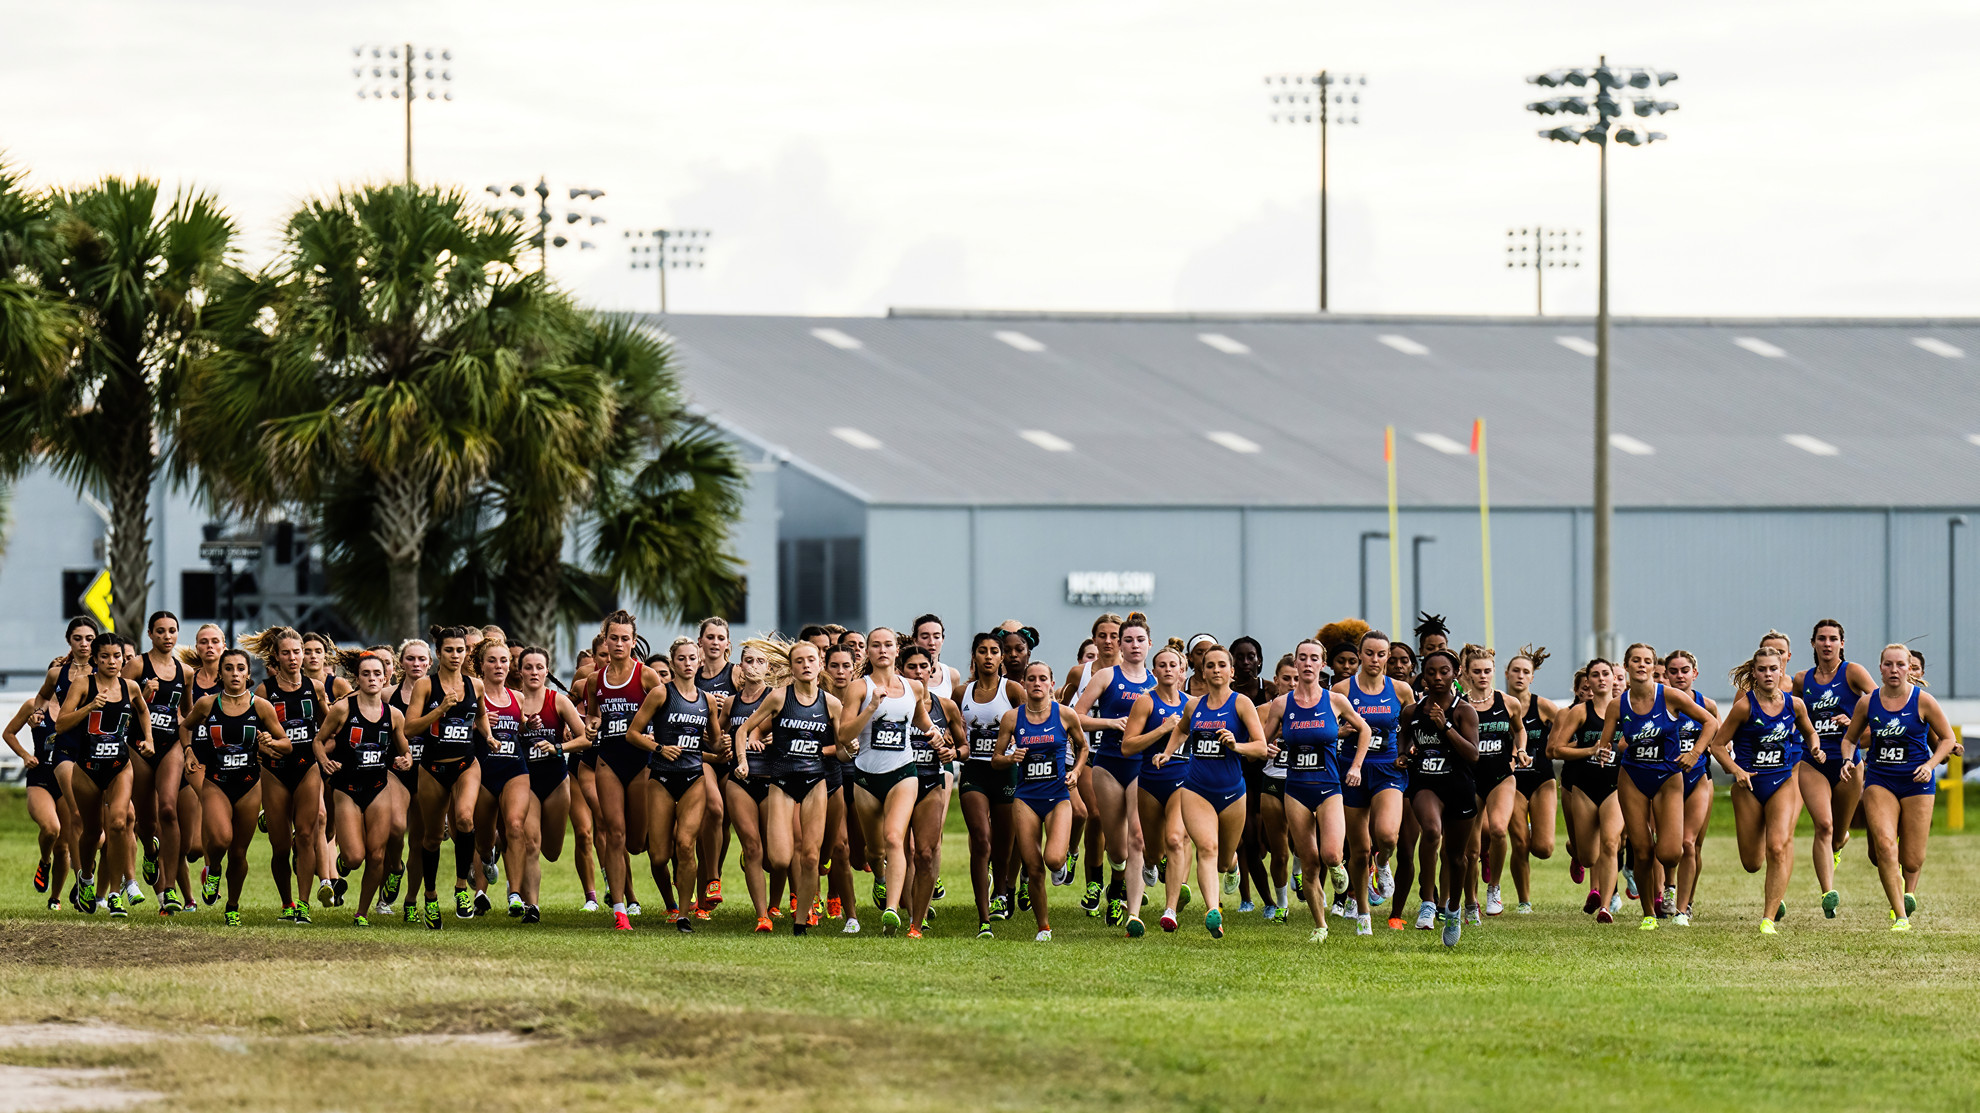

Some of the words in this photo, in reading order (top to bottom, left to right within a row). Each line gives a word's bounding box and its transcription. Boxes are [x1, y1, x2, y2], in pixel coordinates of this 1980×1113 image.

[599, 703, 639, 713] ATLANTIC
[1357, 705, 1391, 714] FLORIDA
[1812, 696, 1840, 711] FGCU
[150, 712, 173, 728] 963
[667, 712, 708, 726] KNIGHT
[779, 718, 828, 733] KNIGHTS
[1193, 720, 1227, 729] FLORIDA
[1290, 720, 1325, 730] FLORIDA
[1815, 719, 1839, 733] 944
[286, 726, 308, 741] 956
[443, 725, 469, 740] 965
[607, 719, 628, 734] 916
[1876, 726, 1906, 737] FGCU
[677, 734, 701, 749] 1015
[875, 730, 903, 745] 984
[1021, 734, 1055, 745] FLORIDA
[1368, 735, 1383, 749] 12
[1760, 729, 1790, 743] FGCU
[95, 742, 120, 756] 955
[498, 740, 515, 754] 20
[789, 738, 819, 754] 1025
[1196, 740, 1221, 754] 905
[1478, 739, 1502, 752] 008
[1636, 745, 1659, 759] 941
[1679, 738, 1695, 752] 35
[223, 753, 248, 767] 962
[912, 749, 934, 763] 026
[1296, 753, 1318, 767] 910
[1756, 750, 1782, 764] 942
[1879, 747, 1904, 760] 943
[1027, 761, 1053, 777] 906
